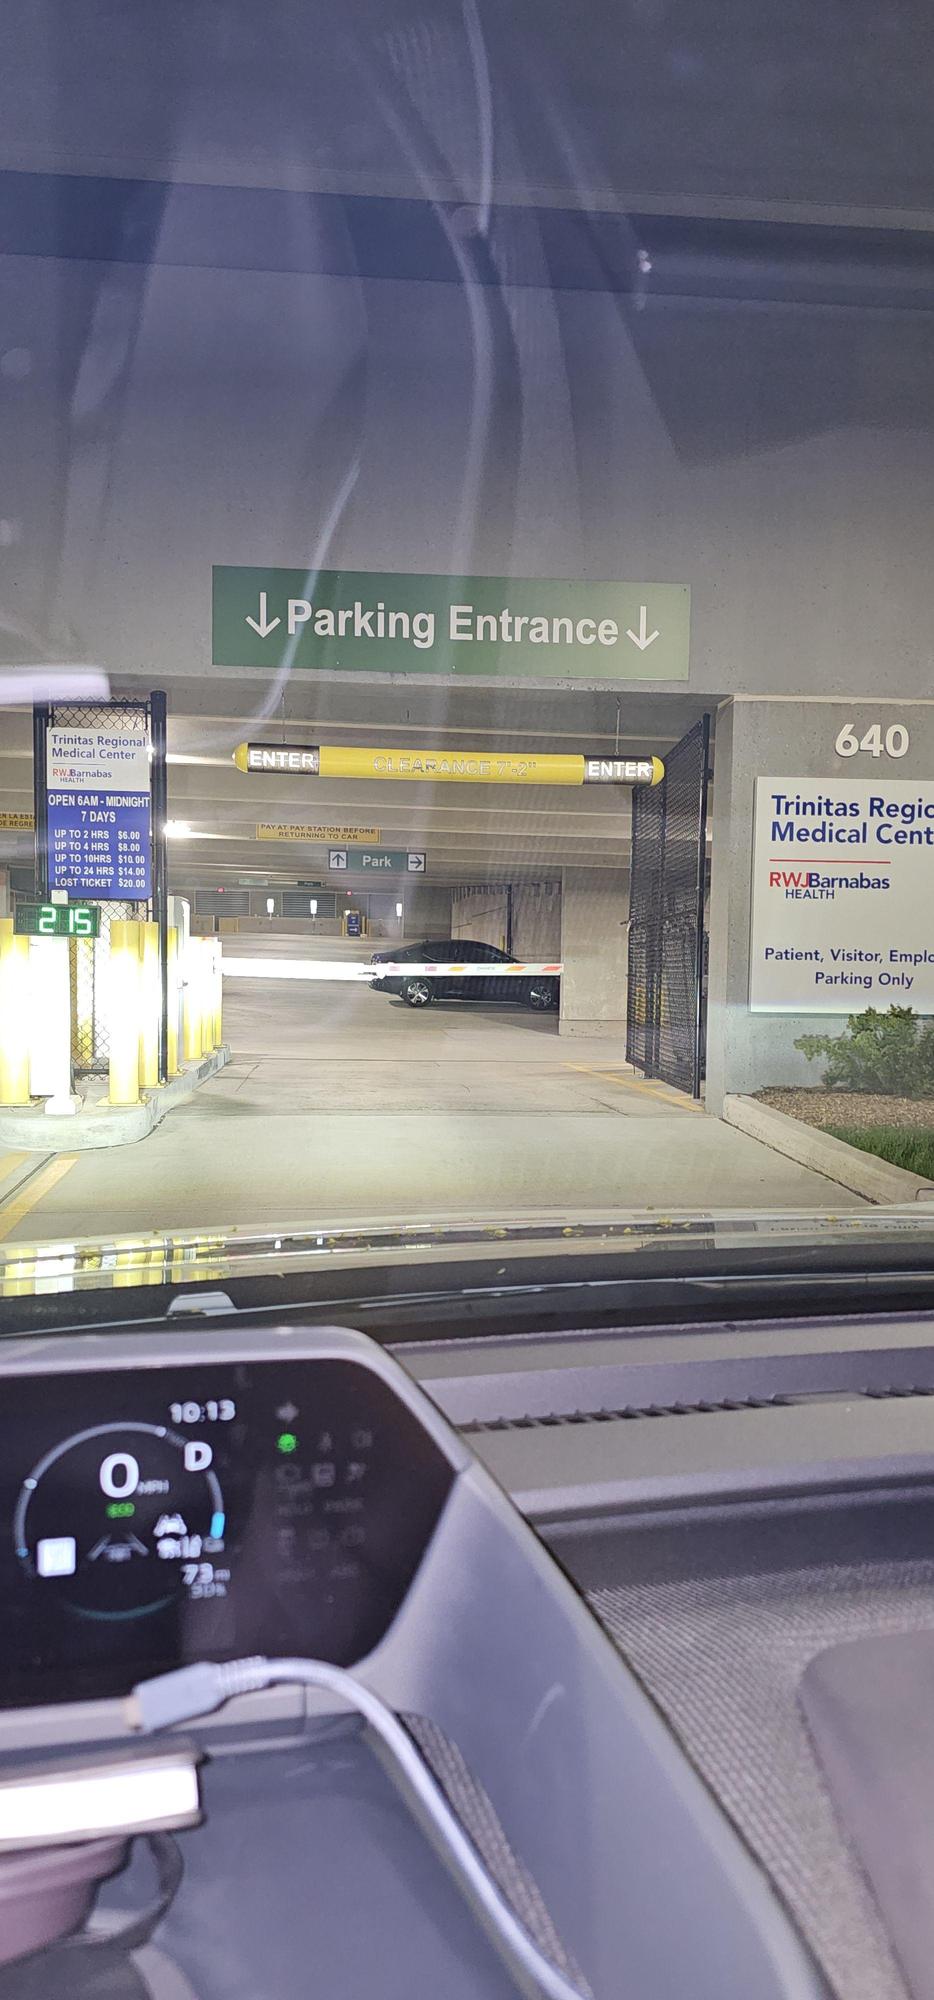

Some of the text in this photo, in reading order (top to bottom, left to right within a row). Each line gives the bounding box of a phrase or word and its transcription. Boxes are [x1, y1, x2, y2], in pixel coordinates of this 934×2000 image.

[287, 598, 618, 648] Parking Entrance
[52, 735, 146, 748] Trinitas Regional
[835, 724, 909, 758] 640
[52, 748, 136, 760] Medical Center
[250, 750, 314, 768] ENTER
[53, 768, 112, 778] RWJBarnabas
[373, 756, 490, 776] CLEARANCE
[588, 760, 650, 777] ENTER
[48, 795, 76, 806] OPEN
[78, 796, 98, 807] 6AM
[106, 796, 150, 808] MIDNIGHT
[771, 795, 860, 817] Trinitas
[81, 811, 116, 823] 7 DAYS
[55, 830, 140, 840] UP TO 2 HRS $6.00
[771, 822, 867, 844] Medical
[55, 842, 140, 852] UP TO 4 HRS $8.00
[55, 854, 67, 862] UP
[70, 854, 81, 862] TO
[118, 855, 145, 864] $10.00
[363, 855, 391, 867] Park
[55, 866, 145, 876] UP TO 24 HRS $14.00
[55, 878, 146, 888] LOST TICKET $20.00
[770, 872, 890, 889] RWJBarnabas
[785, 889, 834, 899] HEALTH
[765, 948, 824, 962] Patient,
[830, 948, 883, 964] Visitor,
[815, 972, 914, 988] Parking Only
[169, 1400, 236, 1423] 10:13
[184, 1441, 212, 1471] D
[100, 1452, 139, 1498] 0
